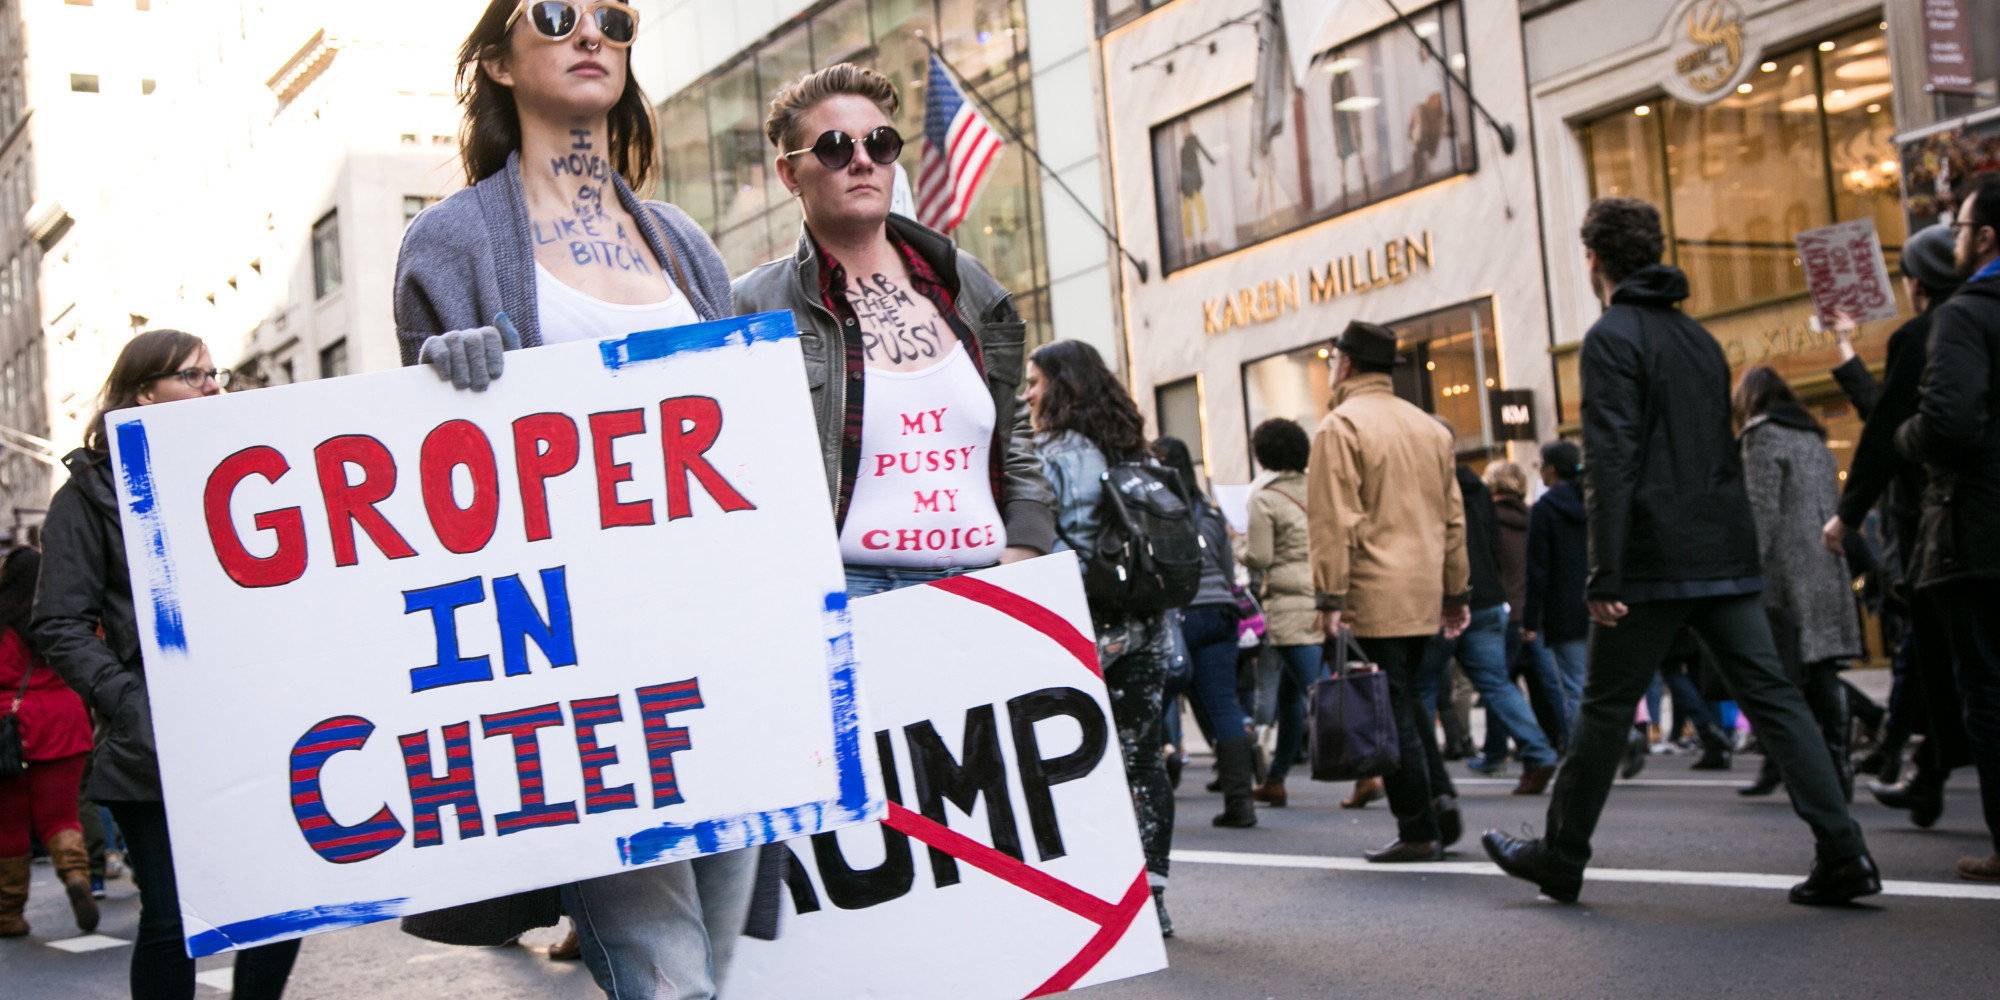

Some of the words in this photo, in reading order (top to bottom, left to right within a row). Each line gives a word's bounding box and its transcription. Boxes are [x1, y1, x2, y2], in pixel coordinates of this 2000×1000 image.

[569, 129, 592, 150] I
[578, 184, 603, 205] ON
[533, 216, 601, 246] LIKE
[616, 222, 632, 246] A
[569, 241, 652, 275] BITCH
[1829, 245, 1852, 275] NO
[1847, 233, 1888, 309] GENDER
[1203, 273, 1301, 335] KAREN
[1309, 230, 1435, 304] MILLEN
[851, 290, 916, 312] THEM
[861, 308, 906, 329] THE
[900, 407, 948, 436] MY
[1501, 405, 1530, 425] KM
[873, 445, 976, 477] PUSSY
[203, 395, 757, 589] GROPER
[912, 488, 959, 513] MY
[861, 525, 996, 551] CHOICE
[402, 565, 578, 694] IN
[289, 676, 706, 864] CHIEF
